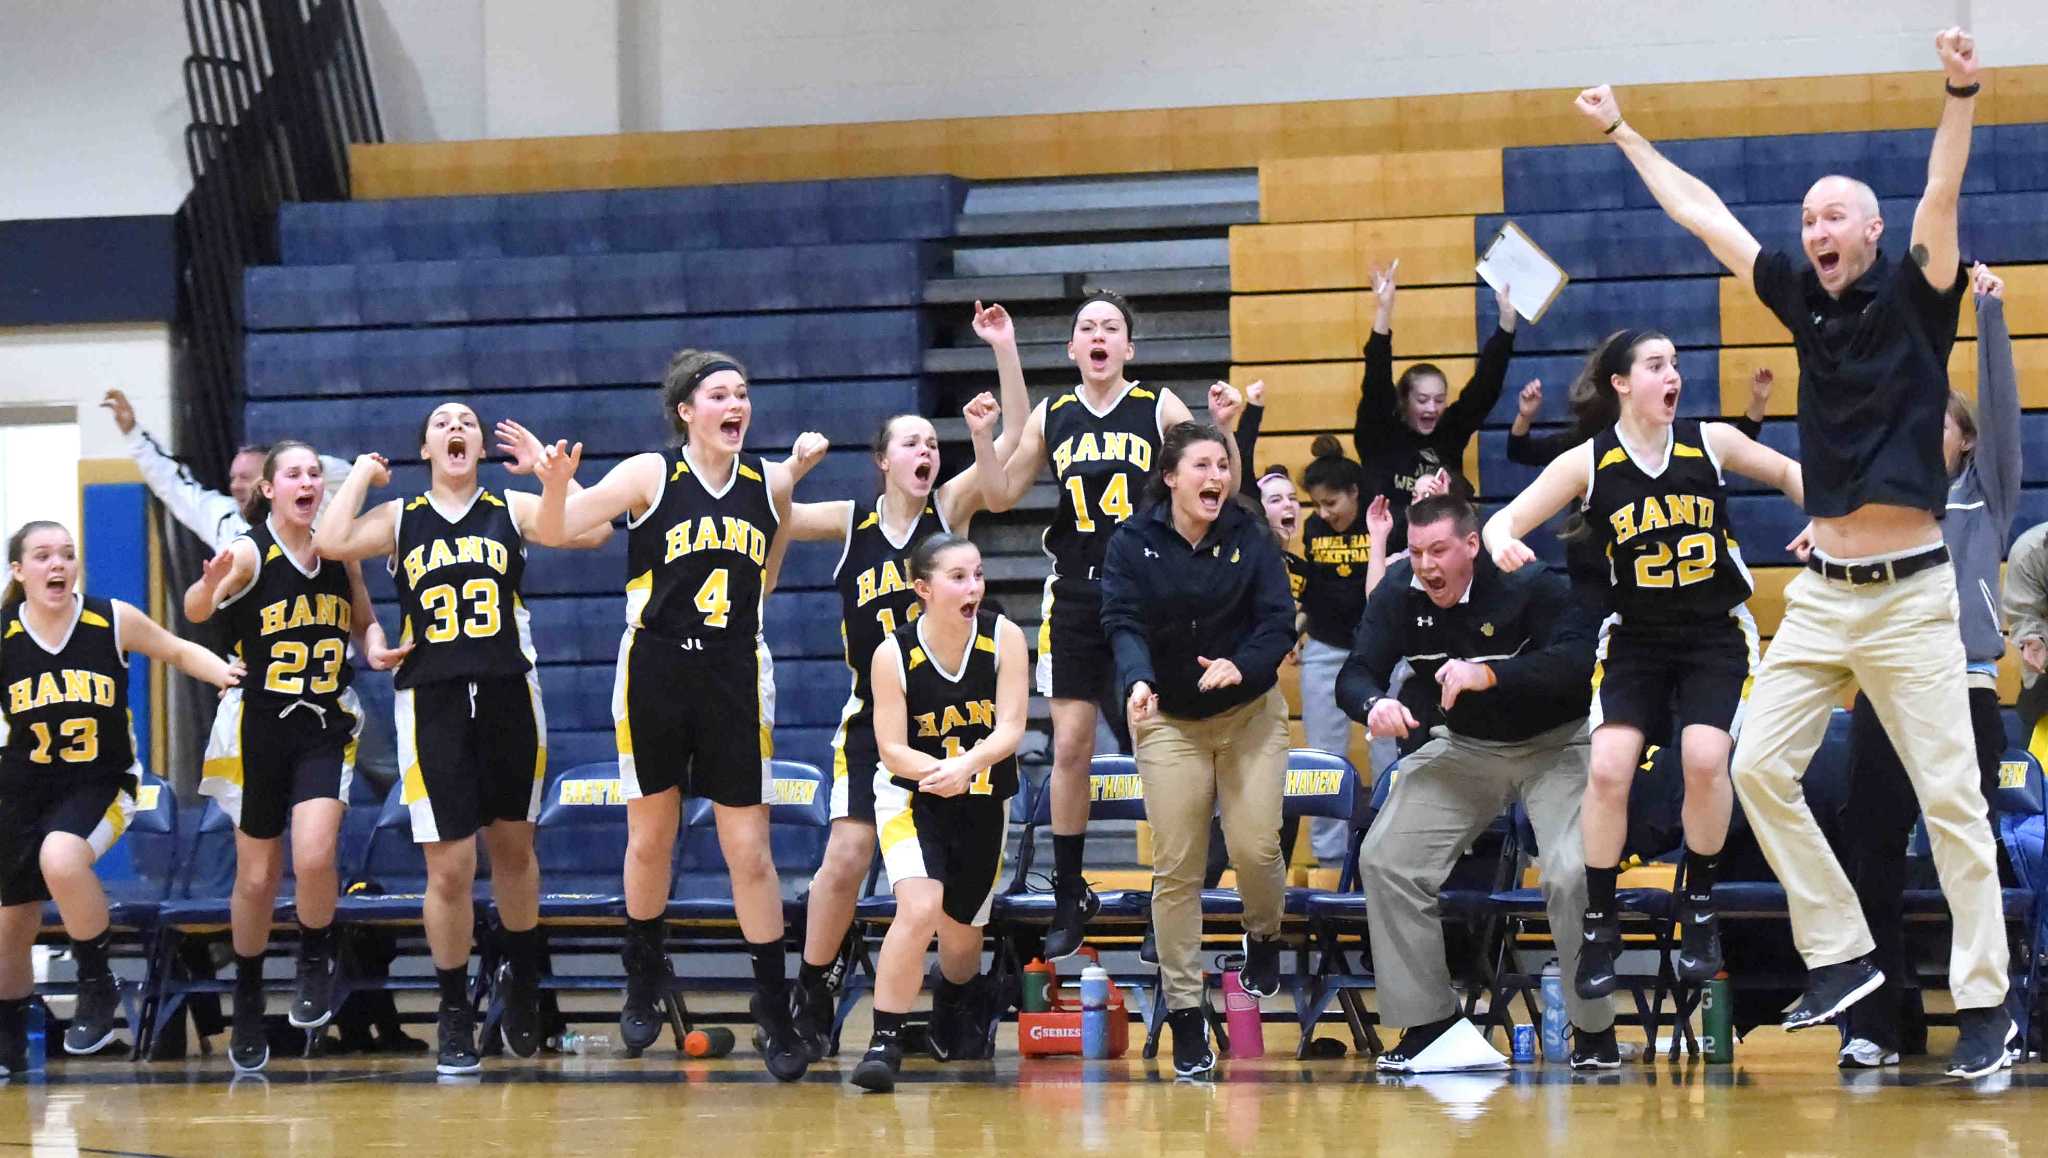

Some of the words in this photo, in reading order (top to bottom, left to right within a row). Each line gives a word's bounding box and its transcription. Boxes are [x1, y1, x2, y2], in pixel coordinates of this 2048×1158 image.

[1052, 431, 1152, 481] HAND
[1065, 472, 1134, 533] 14
[1610, 494, 1716, 545] HAND
[403, 535, 508, 591] HAND
[664, 516, 767, 566] HAND
[1633, 532, 1717, 588] 22
[693, 568, 732, 629] 4
[857, 556, 916, 608] HA
[260, 594, 351, 636] HAND
[419, 577, 502, 644] 33
[8, 668, 116, 715] HAND
[264, 638, 345, 695] 23
[29, 716, 99, 764] 13
[912, 699, 997, 738] HAN
[1285, 770, 1343, 796] HAVEN
